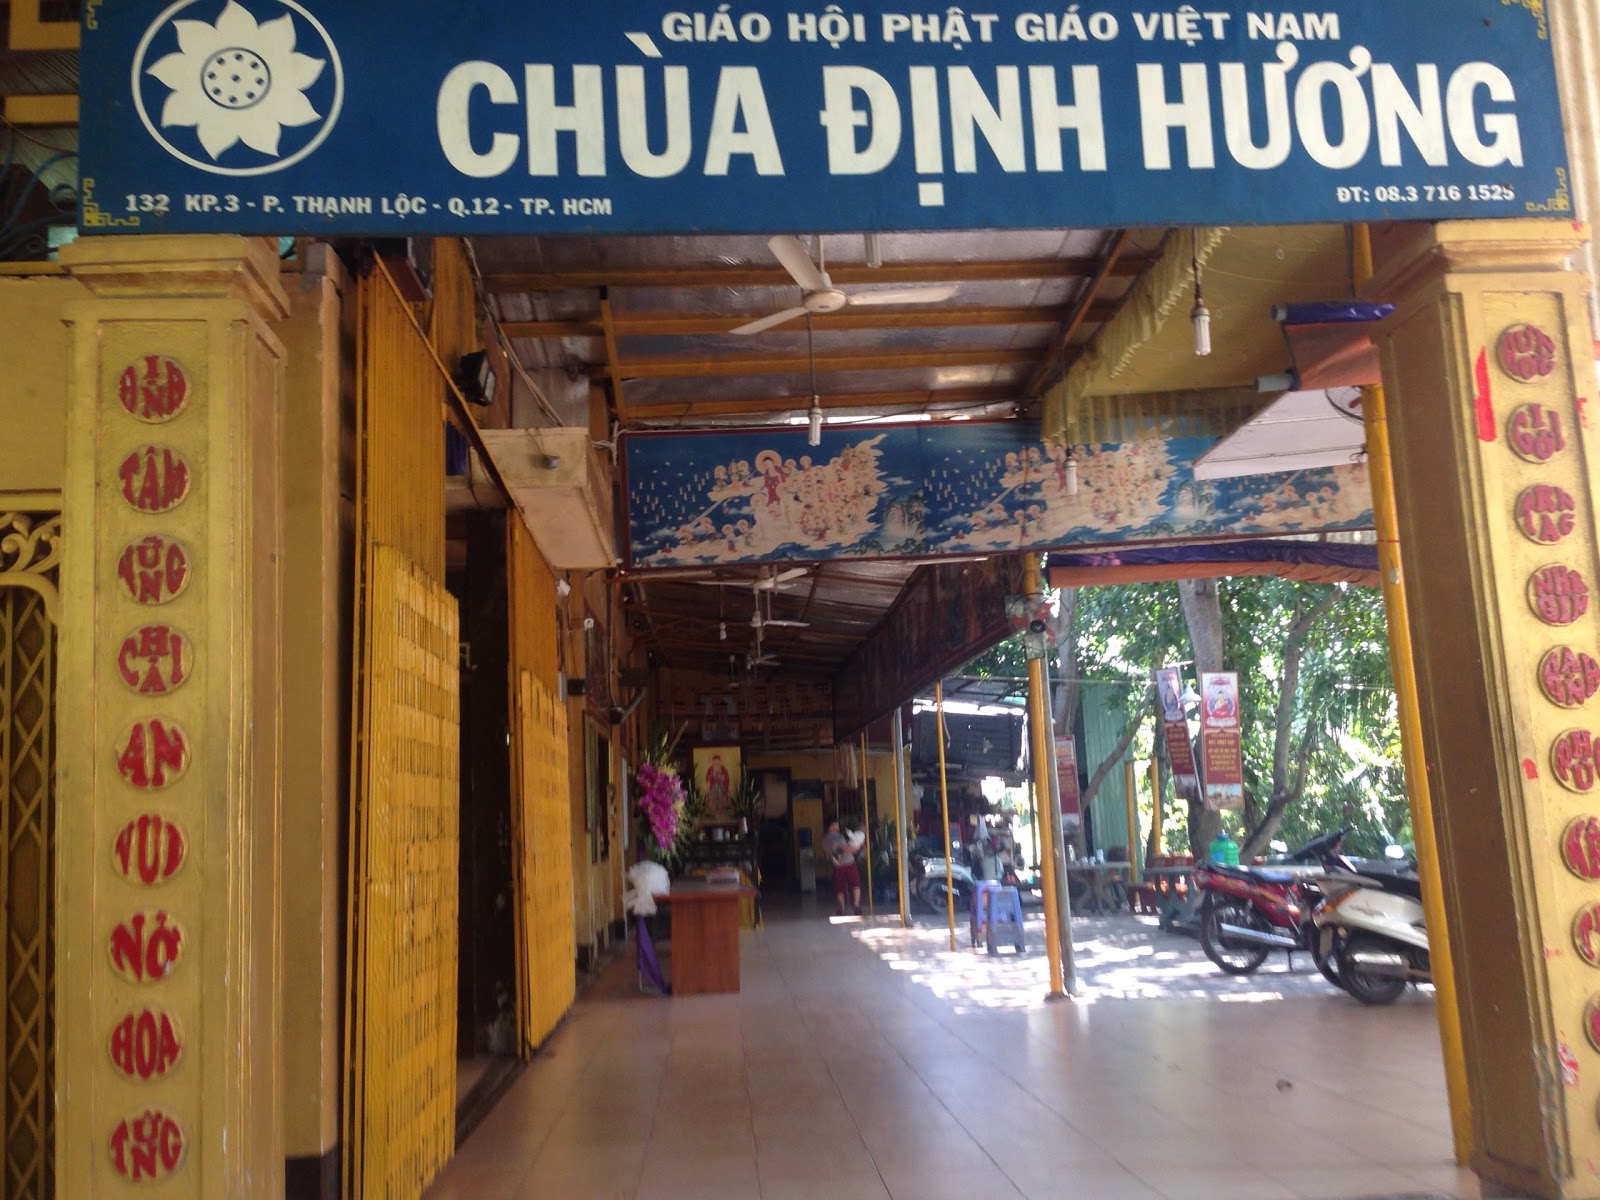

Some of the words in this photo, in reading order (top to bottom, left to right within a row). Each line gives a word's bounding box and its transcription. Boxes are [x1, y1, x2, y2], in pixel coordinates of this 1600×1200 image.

[661, 4, 771, 43] GIÁO
[788, 5, 865, 48] HỘI
[882, 7, 999, 50] PHẬT
[1015, 5, 1119, 42] GIÁO
[1132, 5, 1230, 46] VIỆT
[1247, 12, 1340, 41] NAM
[436, 31, 785, 178] CHÙA
[820, 63, 1107, 206] ĐỊNH
[1136, 41, 1524, 170] HƯƠNG
[126, 193, 170, 212] 132
[185, 194, 240, 212] KP.3
[263, 195, 284, 213] P.
[292, 195, 372, 218] THẠNH
[381, 192, 427, 219] LỘC
[447, 197, 499, 218] Q.12
[519, 198, 555, 215] TP.
[562, 198, 612, 216] HCM
[1336, 186, 1370, 203] ĐT:
[1374, 185, 1419, 202] 08.3
[1423, 185, 1462, 202] 716
[120, 446, 187, 510] TÂM
[117, 719, 183, 788] AN
[116, 814, 181, 884] VUI
[111, 1010, 181, 1079] HOA
